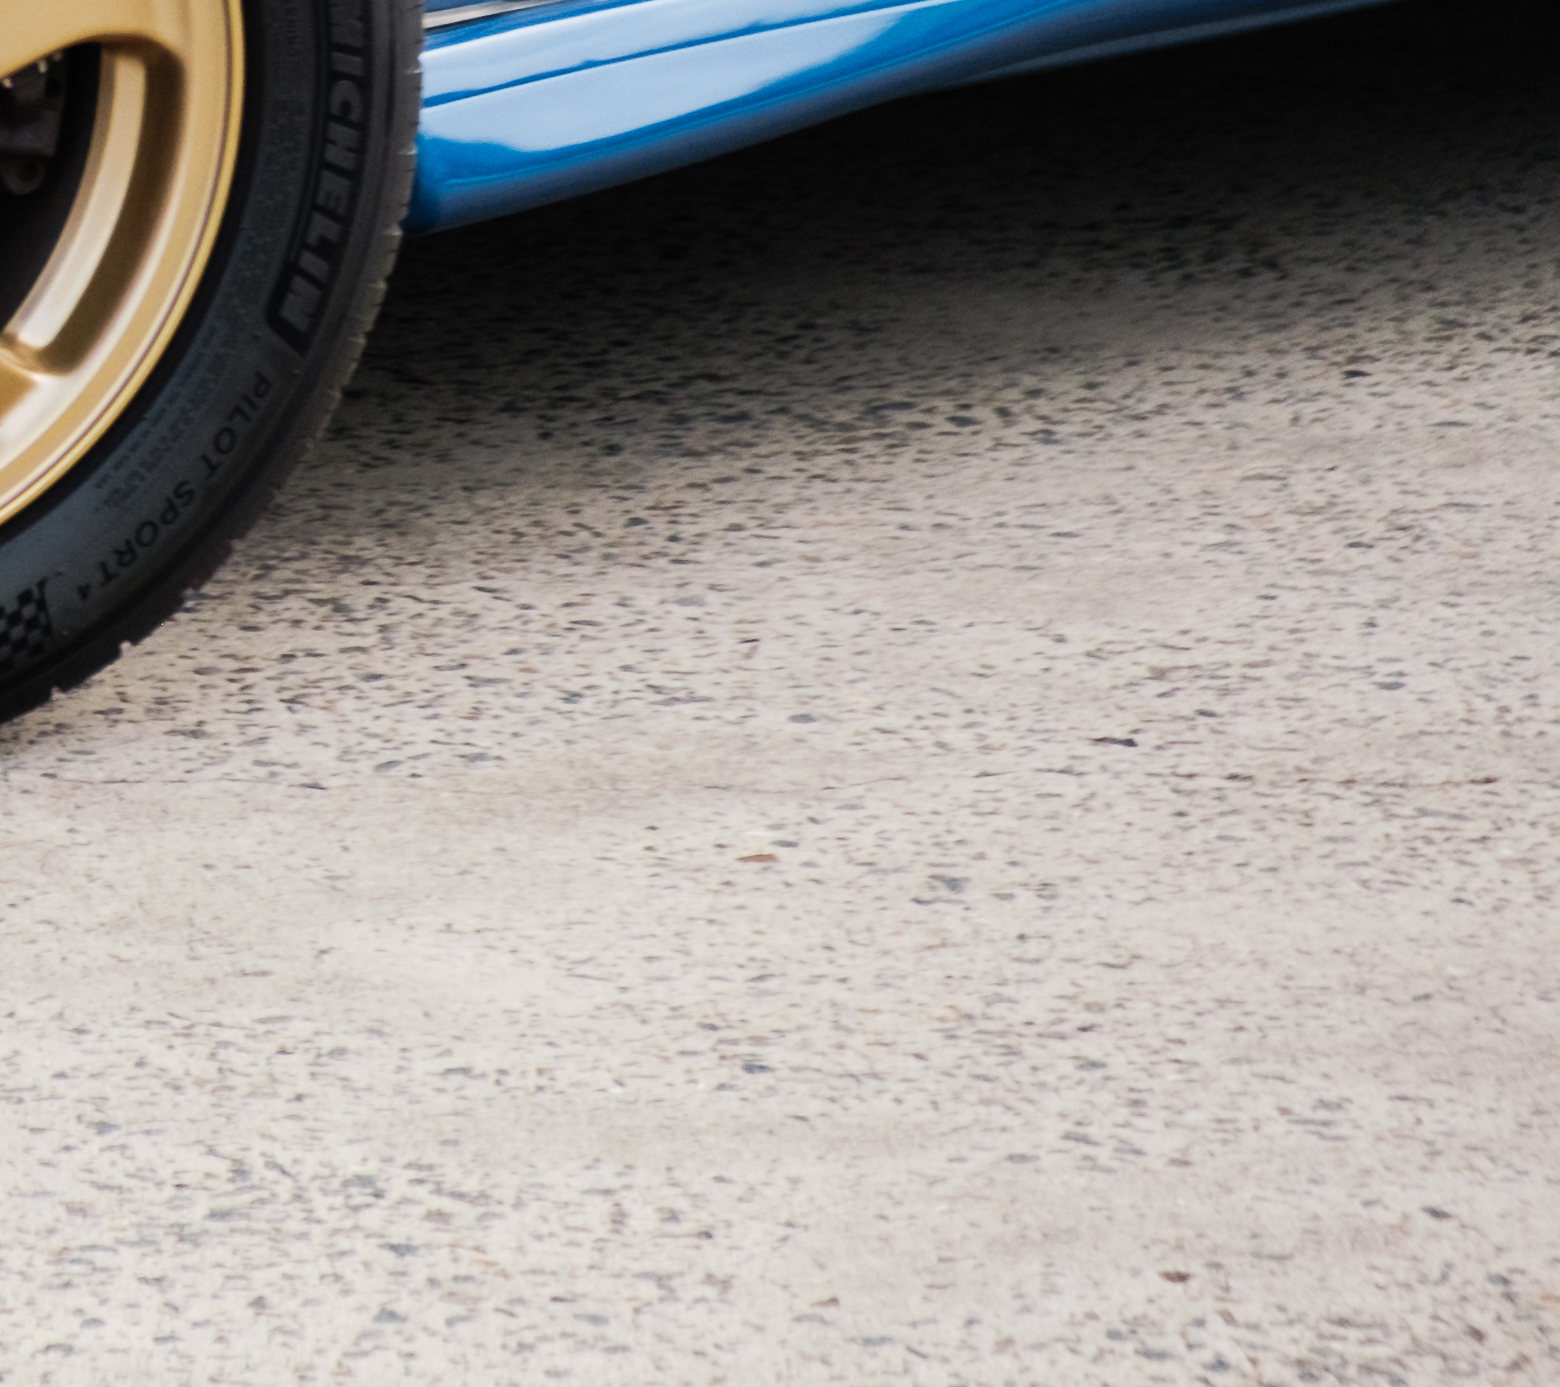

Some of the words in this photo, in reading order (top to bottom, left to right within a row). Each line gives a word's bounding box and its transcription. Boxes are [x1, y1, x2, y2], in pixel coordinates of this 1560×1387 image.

[201, 370, 272, 479] PILOT
[99, 479, 196, 588] SPORT
[77, 583, 91, 601] 4
